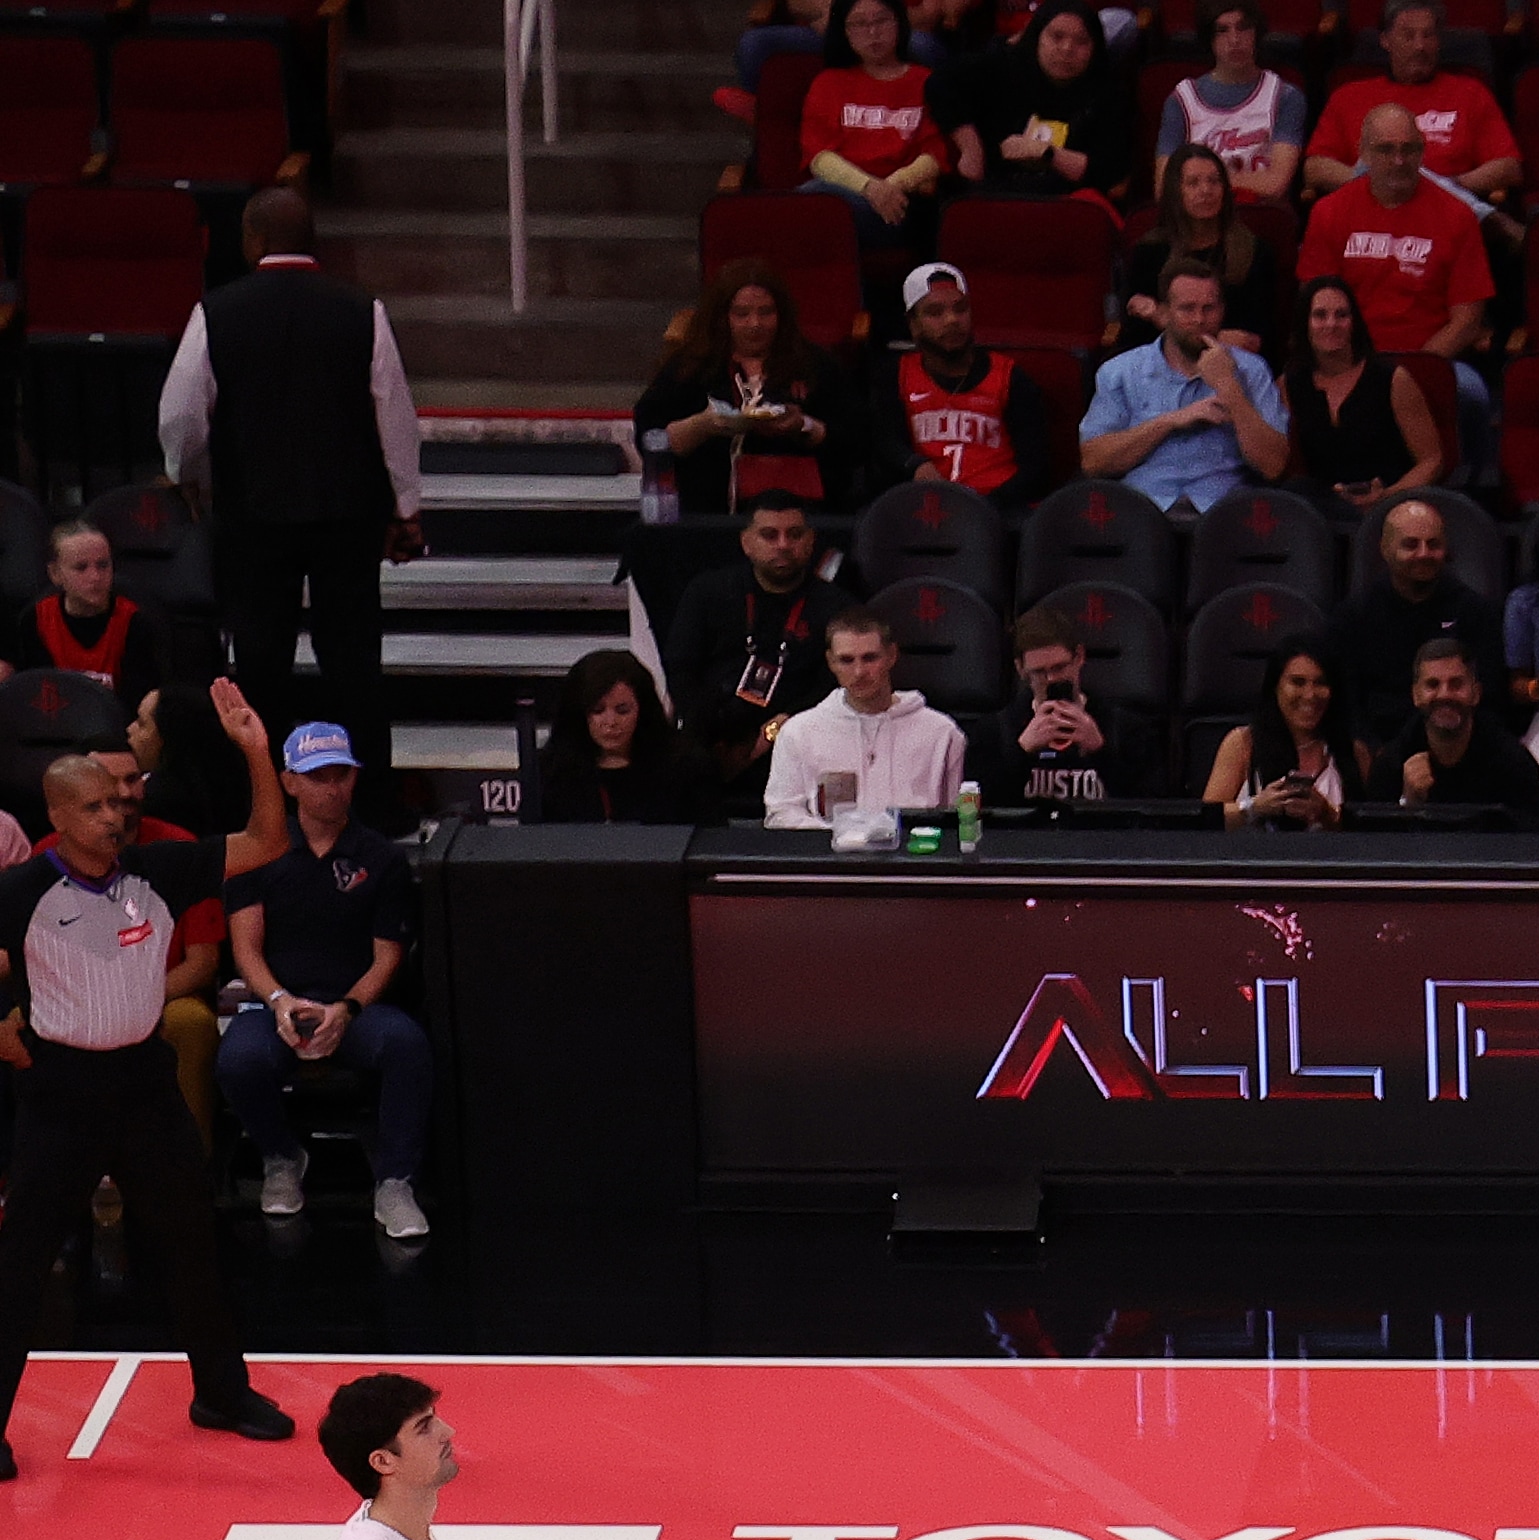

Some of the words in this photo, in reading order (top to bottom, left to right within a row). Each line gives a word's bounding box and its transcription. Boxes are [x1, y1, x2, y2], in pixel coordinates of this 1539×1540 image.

[943, 443, 964, 482] 7
[480, 780, 520, 812] 120
[975, 972, 1384, 1104] ALL
